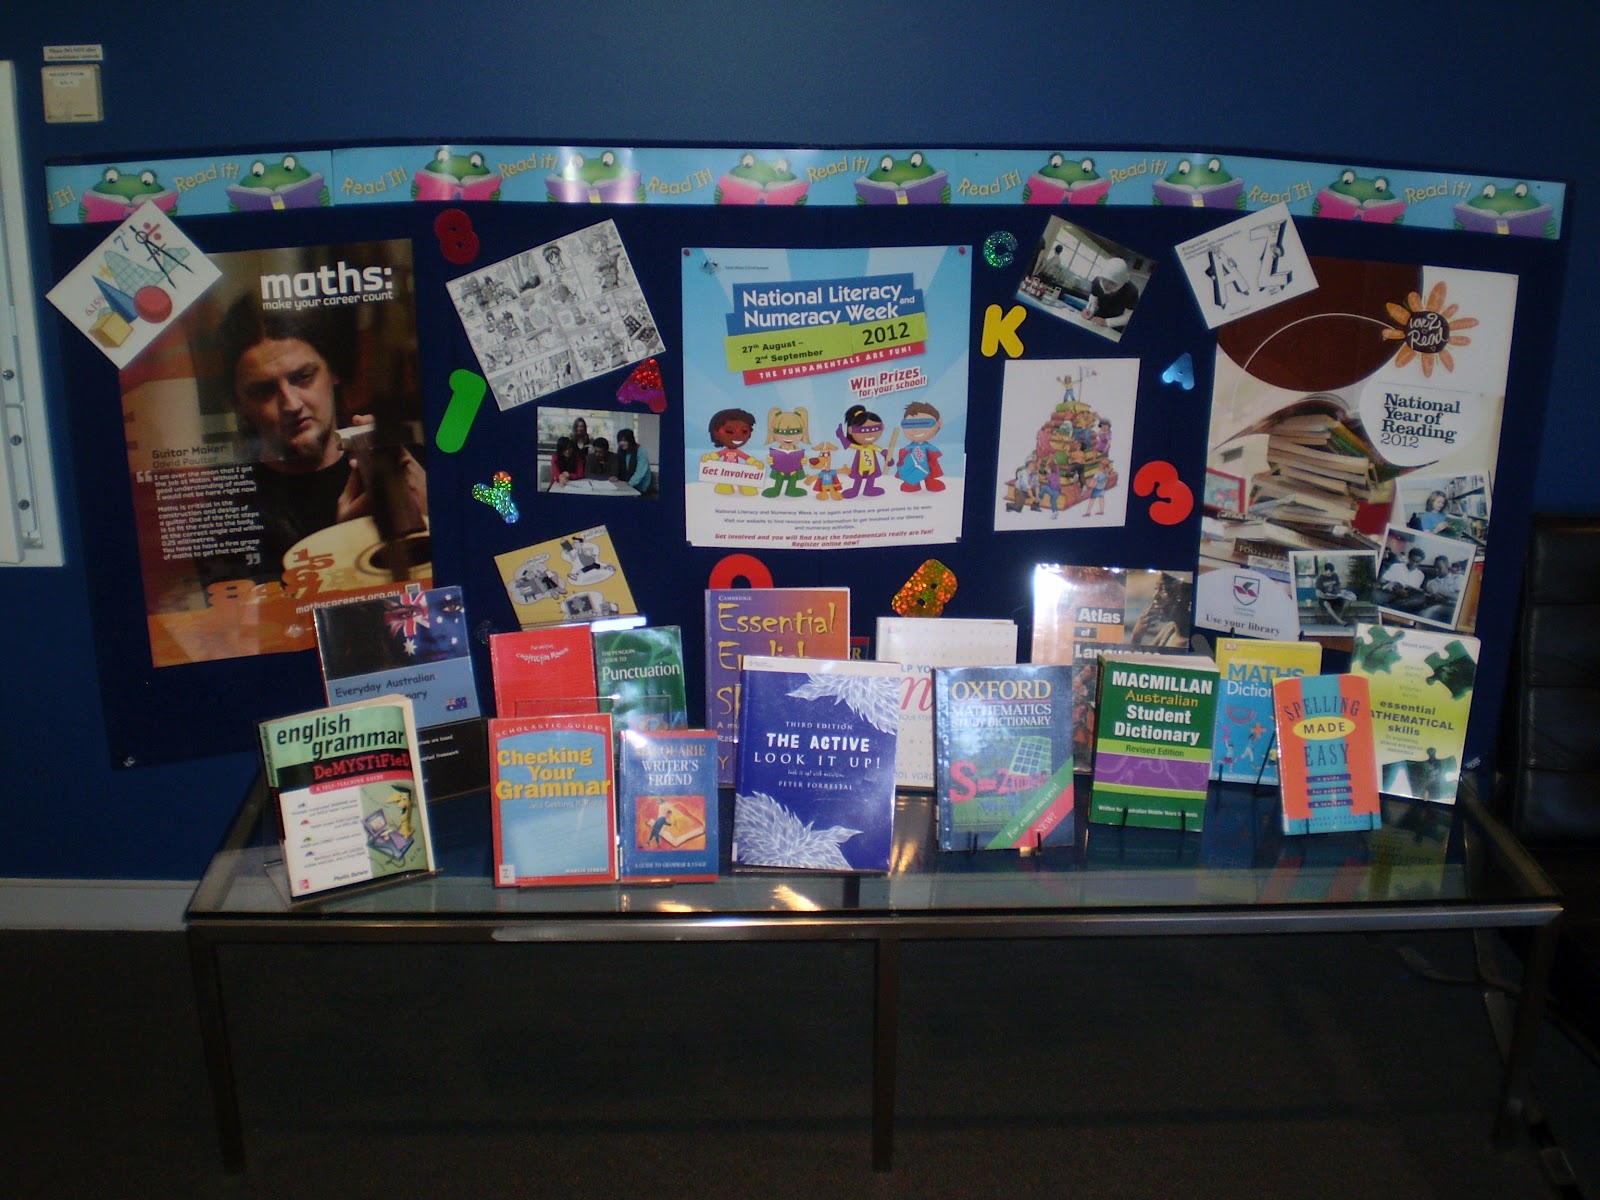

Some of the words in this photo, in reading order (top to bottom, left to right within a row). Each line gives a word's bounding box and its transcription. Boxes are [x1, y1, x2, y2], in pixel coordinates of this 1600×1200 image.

[498, 153, 538, 179] Read
[541, 152, 559, 171] it!
[806, 156, 848, 183] Read
[851, 156, 871, 174] it!
[1108, 159, 1147, 184] Read
[1150, 159, 1168, 175] it!
[173, 163, 218, 193] Read
[221, 162, 241, 179] it!
[340, 176, 388, 196] Read
[388, 165, 409, 188] It!
[646, 176, 692, 195] Read
[692, 167, 714, 188] It!
[957, 177, 1000, 197] Read
[1002, 169, 1023, 190] It!
[1248, 184, 1291, 204] Read
[1292, 180, 1314, 201] It!
[1404, 181, 1448, 204] Read
[1451, 180, 1474, 199] it!
[260, 261, 393, 299] maths:
[262, 300, 292, 310] make
[294, 299, 322, 310] your
[323, 295, 360, 306] career
[362, 290, 393, 302] count
[742, 287, 823, 308] National
[828, 284, 902, 305] Literacy
[899, 295, 916, 305] and
[744, 308, 841, 329] Numeracy
[845, 301, 899, 322] Week
[862, 321, 911, 346] 2012
[980, 303, 1027, 358] K
[1407, 327, 1449, 349] Read
[762, 339, 797, 352] August
[771, 348, 824, 362] September
[759, 370, 778, 379] THE
[782, 355, 861, 376] FUNDAMENTALS
[864, 351, 885, 362] ARE
[888, 345, 913, 357] FUN!
[850, 375, 876, 391] Win
[879, 368, 920, 386] Prizes
[858, 388, 871, 398] for
[872, 385, 894, 397] your
[895, 377, 926, 391] school!
[1385, 393, 1461, 414] National
[1384, 406, 1423, 423] Year
[1424, 412, 1444, 425] of
[1380, 432, 1419, 448] 2012
[1381, 419, 1455, 444] Reading
[152, 448, 189, 459] Guitar
[191, 444, 226, 455] Maker
[153, 460, 181, 469] David
[702, 465, 719, 476] Get
[720, 467, 764, 481] Involved!
[718, 602, 836, 635] Essential
[1078, 607, 1121, 624] Atlas
[1206, 614, 1222, 623] Use
[1225, 619, 1246, 628] your
[1248, 622, 1280, 636] library
[1080, 629, 1091, 637] of
[602, 662, 680, 681] Punctuation
[335, 682, 382, 698] Everyday
[386, 672, 436, 689] Australian
[951, 679, 1052, 701] OXFORD
[1112, 670, 1213, 695] MACMILLAN
[1226, 681, 1272, 698] Dictio
[1125, 690, 1199, 707] Australian
[1284, 696, 1361, 721] SPELLING
[1379, 701, 1436, 715] essential
[951, 704, 1052, 717] MATHEMATICS
[1126, 704, 1192, 725] Student
[1369, 710, 1454, 731] ATHEMATICAL
[277, 713, 352, 747] english
[495, 722, 561, 737] SCHOLASTIC
[567, 723, 607, 732] GUIDES
[785, 721, 813, 729] THIRD
[816, 722, 853, 731] EDITION
[951, 717, 985, 728] STUDY
[988, 716, 1052, 727] DICTIONARY
[1303, 722, 1346, 734] MADE
[1388, 724, 1420, 736] skills
[766, 732, 800, 749] THE
[809, 735, 870, 753] ACTIVE
[1114, 721, 1200, 746] Dictionary
[311, 730, 405, 761] grammar
[497, 746, 593, 766] Checking
[1125, 744, 1156, 755] Revised
[1157, 746, 1185, 757] Edition
[1304, 743, 1349, 767] EASY
[642, 760, 699, 772] WRITER'S
[754, 751, 806, 766] LOOK
[818, 756, 836, 767] IT
[849, 757, 881, 769] UP!
[527, 765, 576, 782] Your
[648, 773, 692, 786] FRIEND
[495, 779, 611, 800] Grammar
[778, 780, 803, 789] PETER
[806, 781, 852, 791] FORRESTAL
[1034, 812, 1058, 834] NEW!
